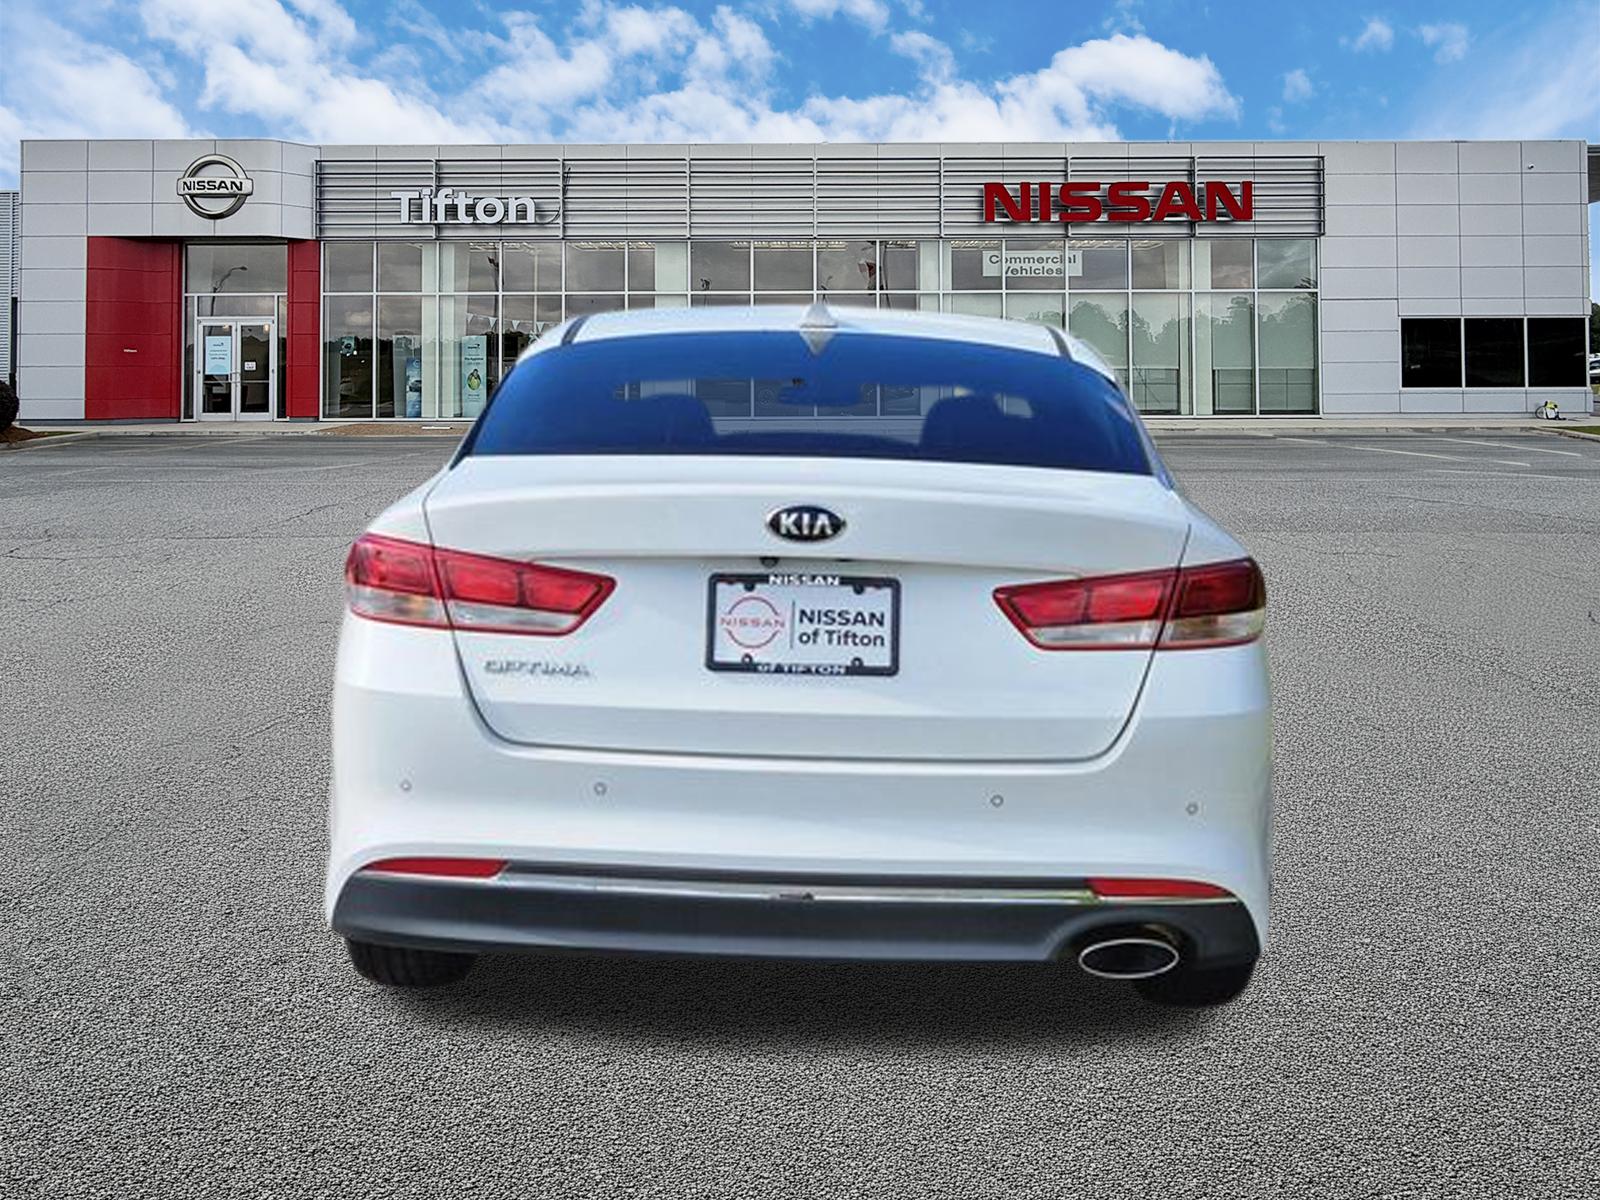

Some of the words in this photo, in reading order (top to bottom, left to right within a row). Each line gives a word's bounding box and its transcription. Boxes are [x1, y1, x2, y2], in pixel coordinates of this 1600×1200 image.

[182, 180, 243, 191] NISSAN
[390, 187, 536, 224] Tifton
[983, 181, 1253, 222] NISSAN
[778, 512, 834, 536] KIA
[768, 574, 841, 587] NISSAN
[720, 616, 785, 629] NISSAN
[799, 609, 885, 627] NISSAN
[798, 629, 820, 645] of
[824, 630, 886, 648] Tifton
